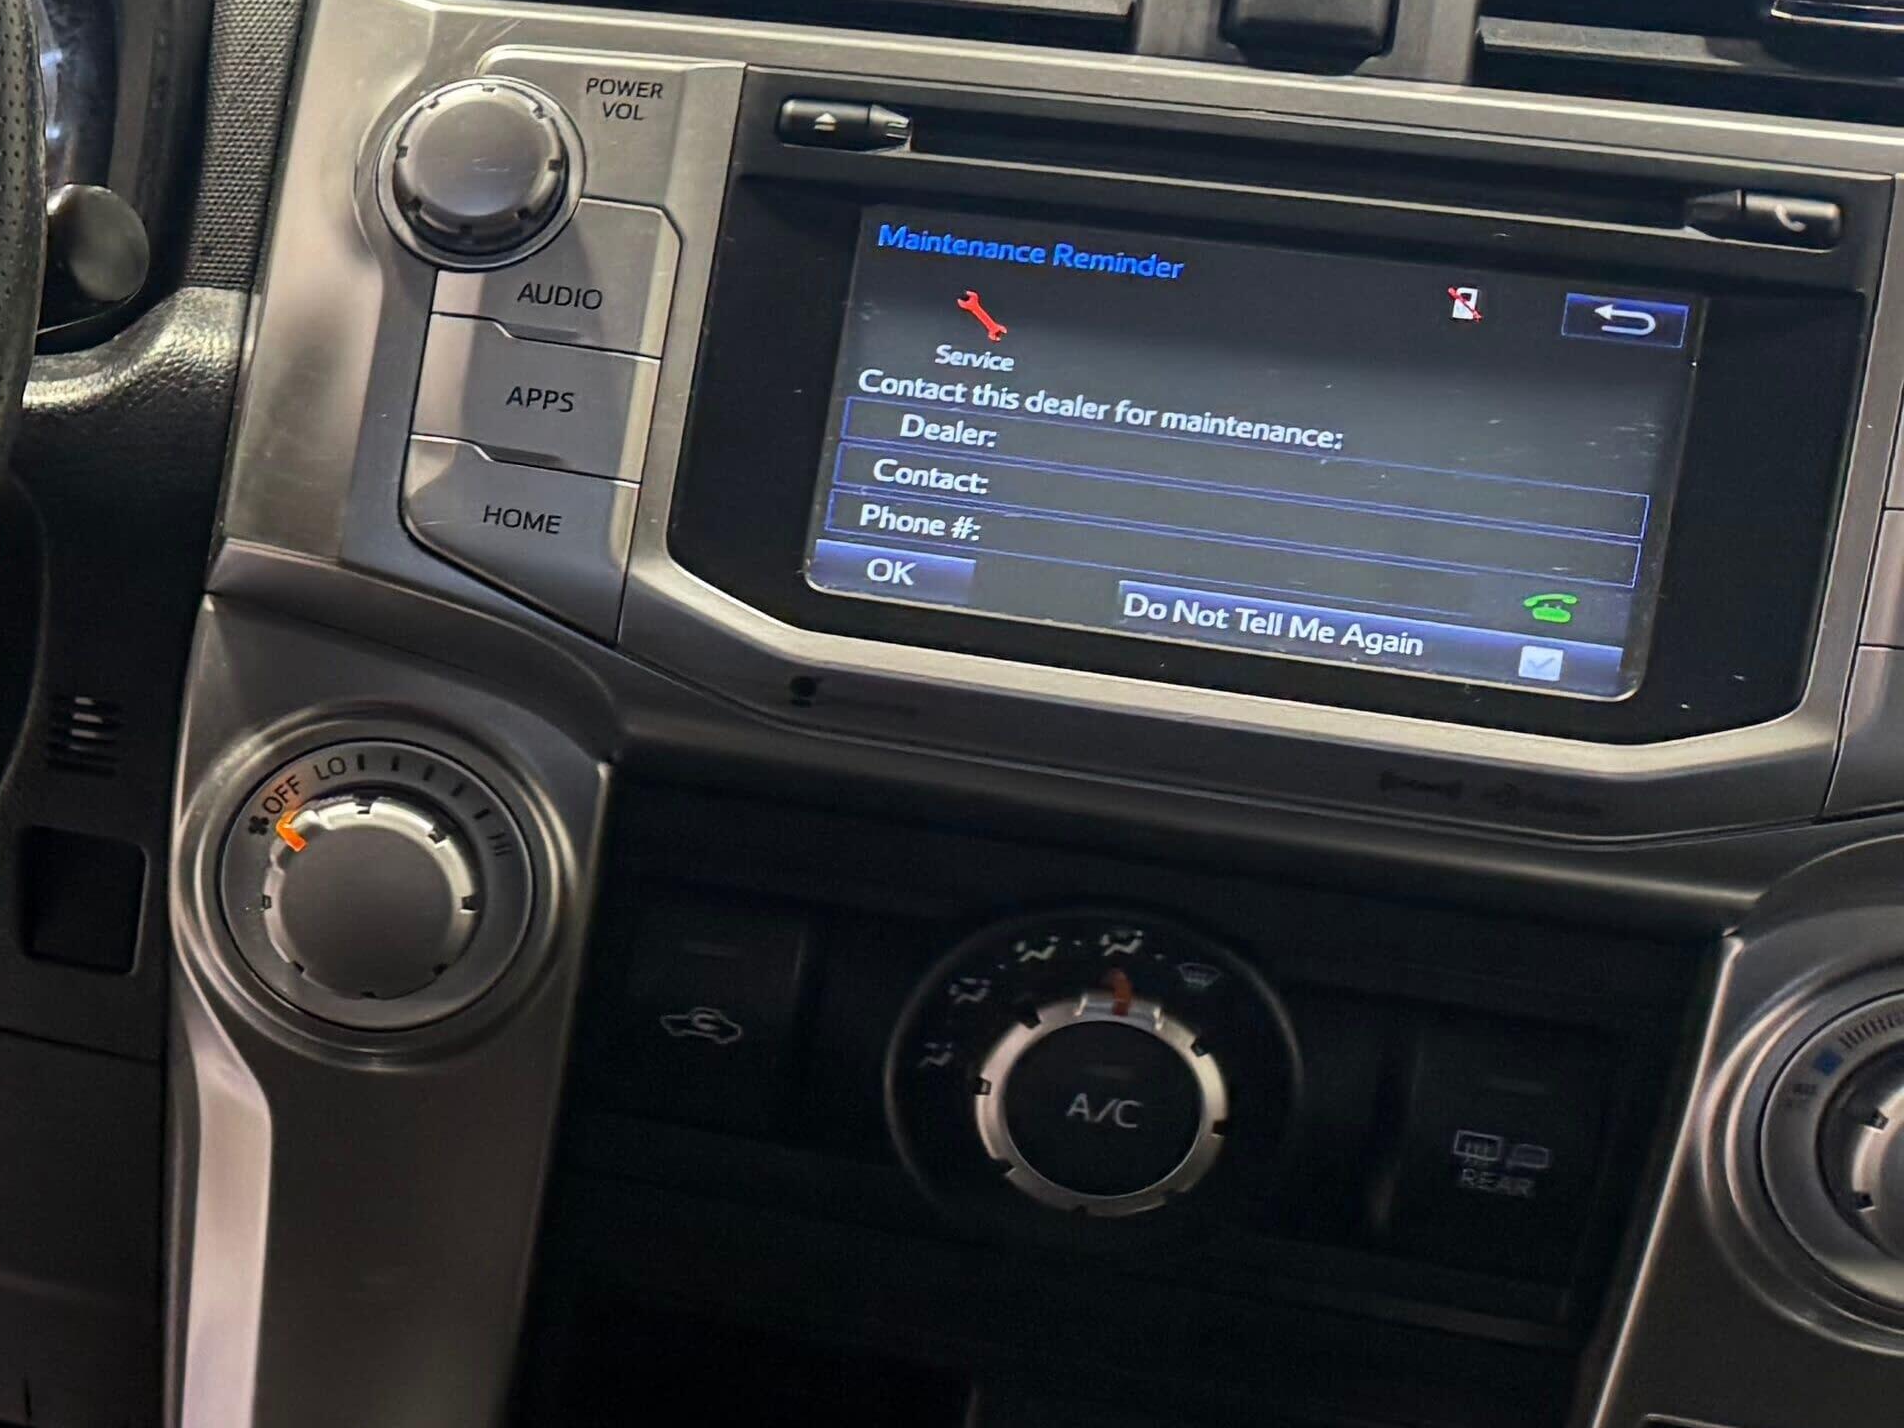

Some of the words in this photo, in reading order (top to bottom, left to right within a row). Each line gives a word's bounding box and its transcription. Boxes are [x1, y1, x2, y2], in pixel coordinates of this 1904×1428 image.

[585, 75, 665, 101] POWER
[601, 100, 646, 123] VOL
[877, 223, 1046, 266] Maintenance
[1052, 242, 1185, 282] Reminder
[516, 283, 604, 311] AUDIO
[934, 343, 1015, 373] Service
[505, 385, 576, 414] APPS
[858, 369, 968, 408] Contact
[972, 380, 1020, 411] this
[1024, 385, 1110, 422] dealer
[1117, 399, 1156, 429] for
[1159, 402, 1344, 452] maintenance:
[899, 413, 998, 450] Dealer:
[871, 458, 989, 496] Contact:
[482, 503, 563, 536] HOME
[858, 504, 947, 540] Phone
[949, 512, 982, 544] #:
[865, 556, 917, 588] OK
[1122, 591, 1166, 624] Do
[1172, 595, 1229, 630] Not
[1234, 603, 1281, 637] Tell
[1287, 608, 1335, 644] Me
[1338, 615, 1424, 659] Again
[312, 756, 348, 781] LO
[261, 774, 301, 815] OFF
[1065, 1090, 1143, 1131] A/C
[1458, 1166, 1535, 1200] REAR
